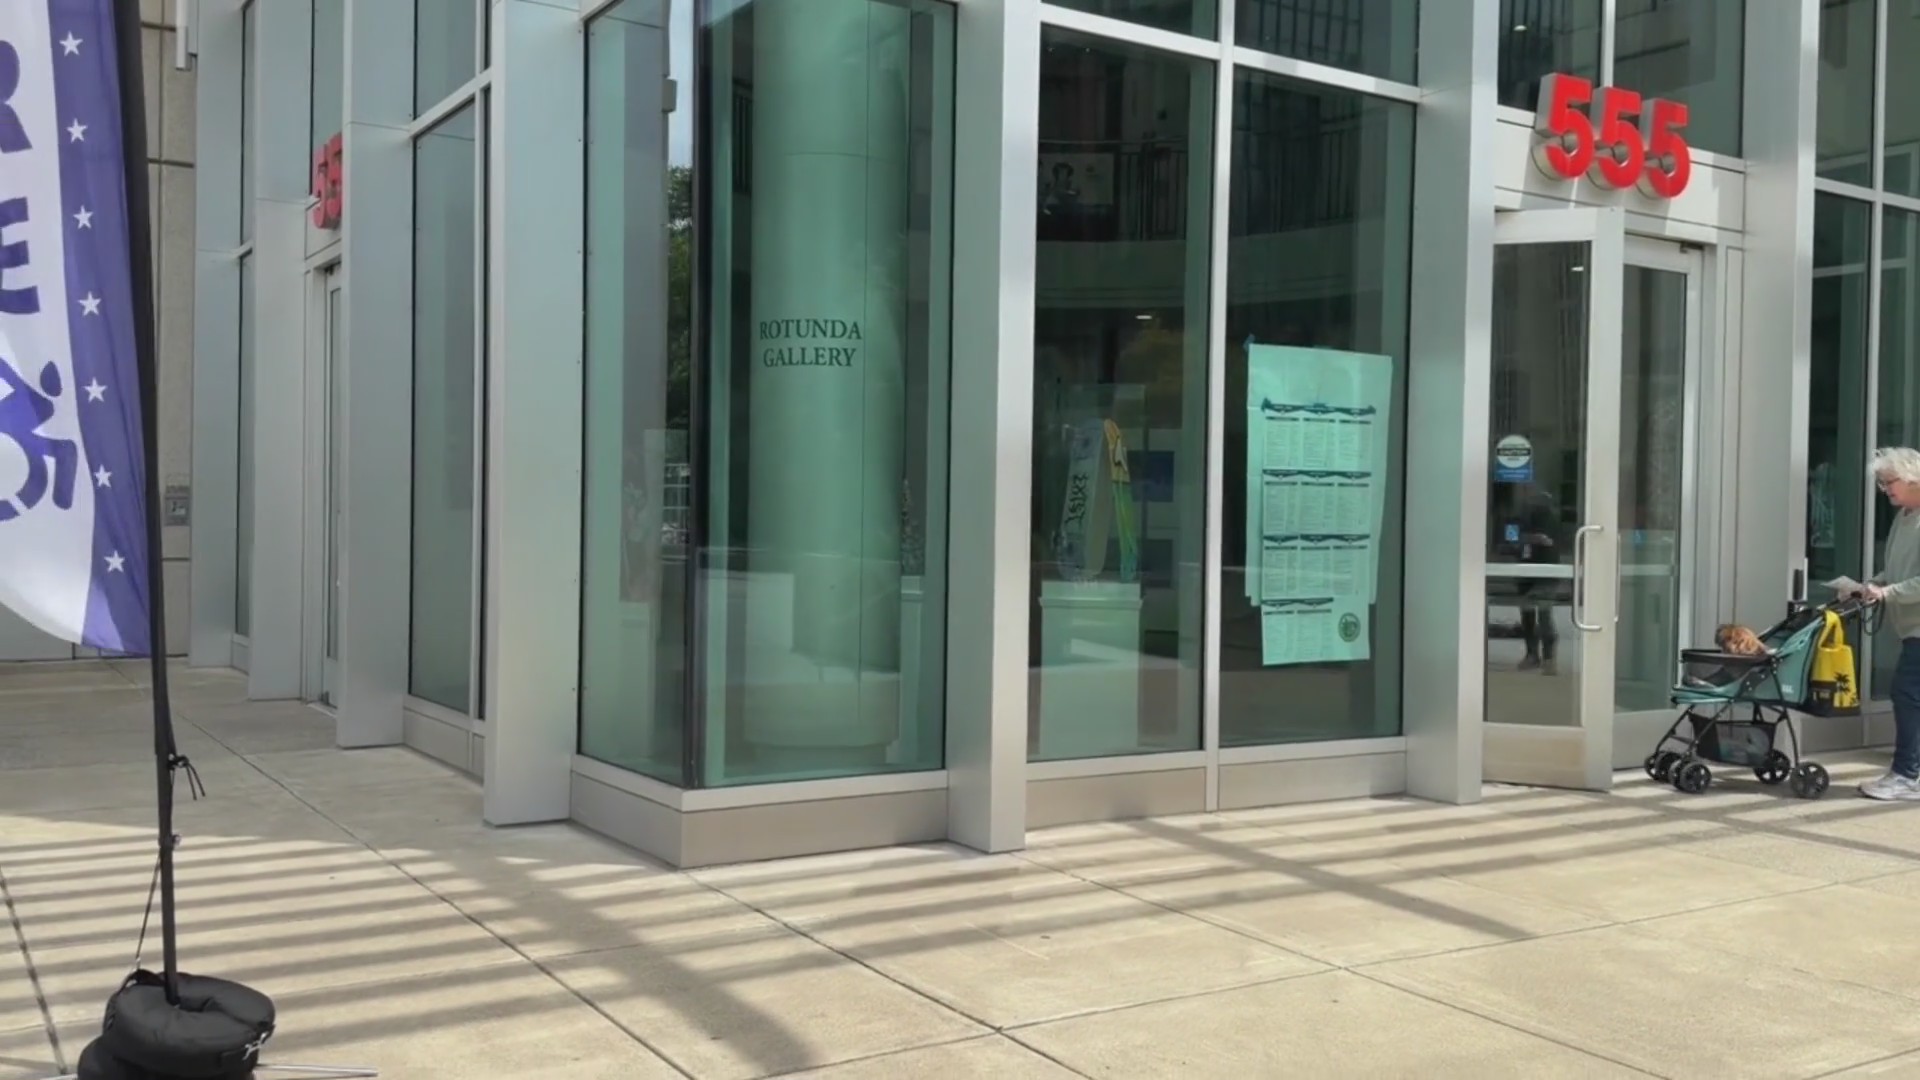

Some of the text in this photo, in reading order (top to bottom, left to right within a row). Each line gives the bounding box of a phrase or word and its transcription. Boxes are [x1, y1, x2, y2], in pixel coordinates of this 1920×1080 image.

[1535, 73, 1691, 199] 555
[759, 319, 862, 340] ROTUNDA
[763, 346, 857, 367] GALLERY
